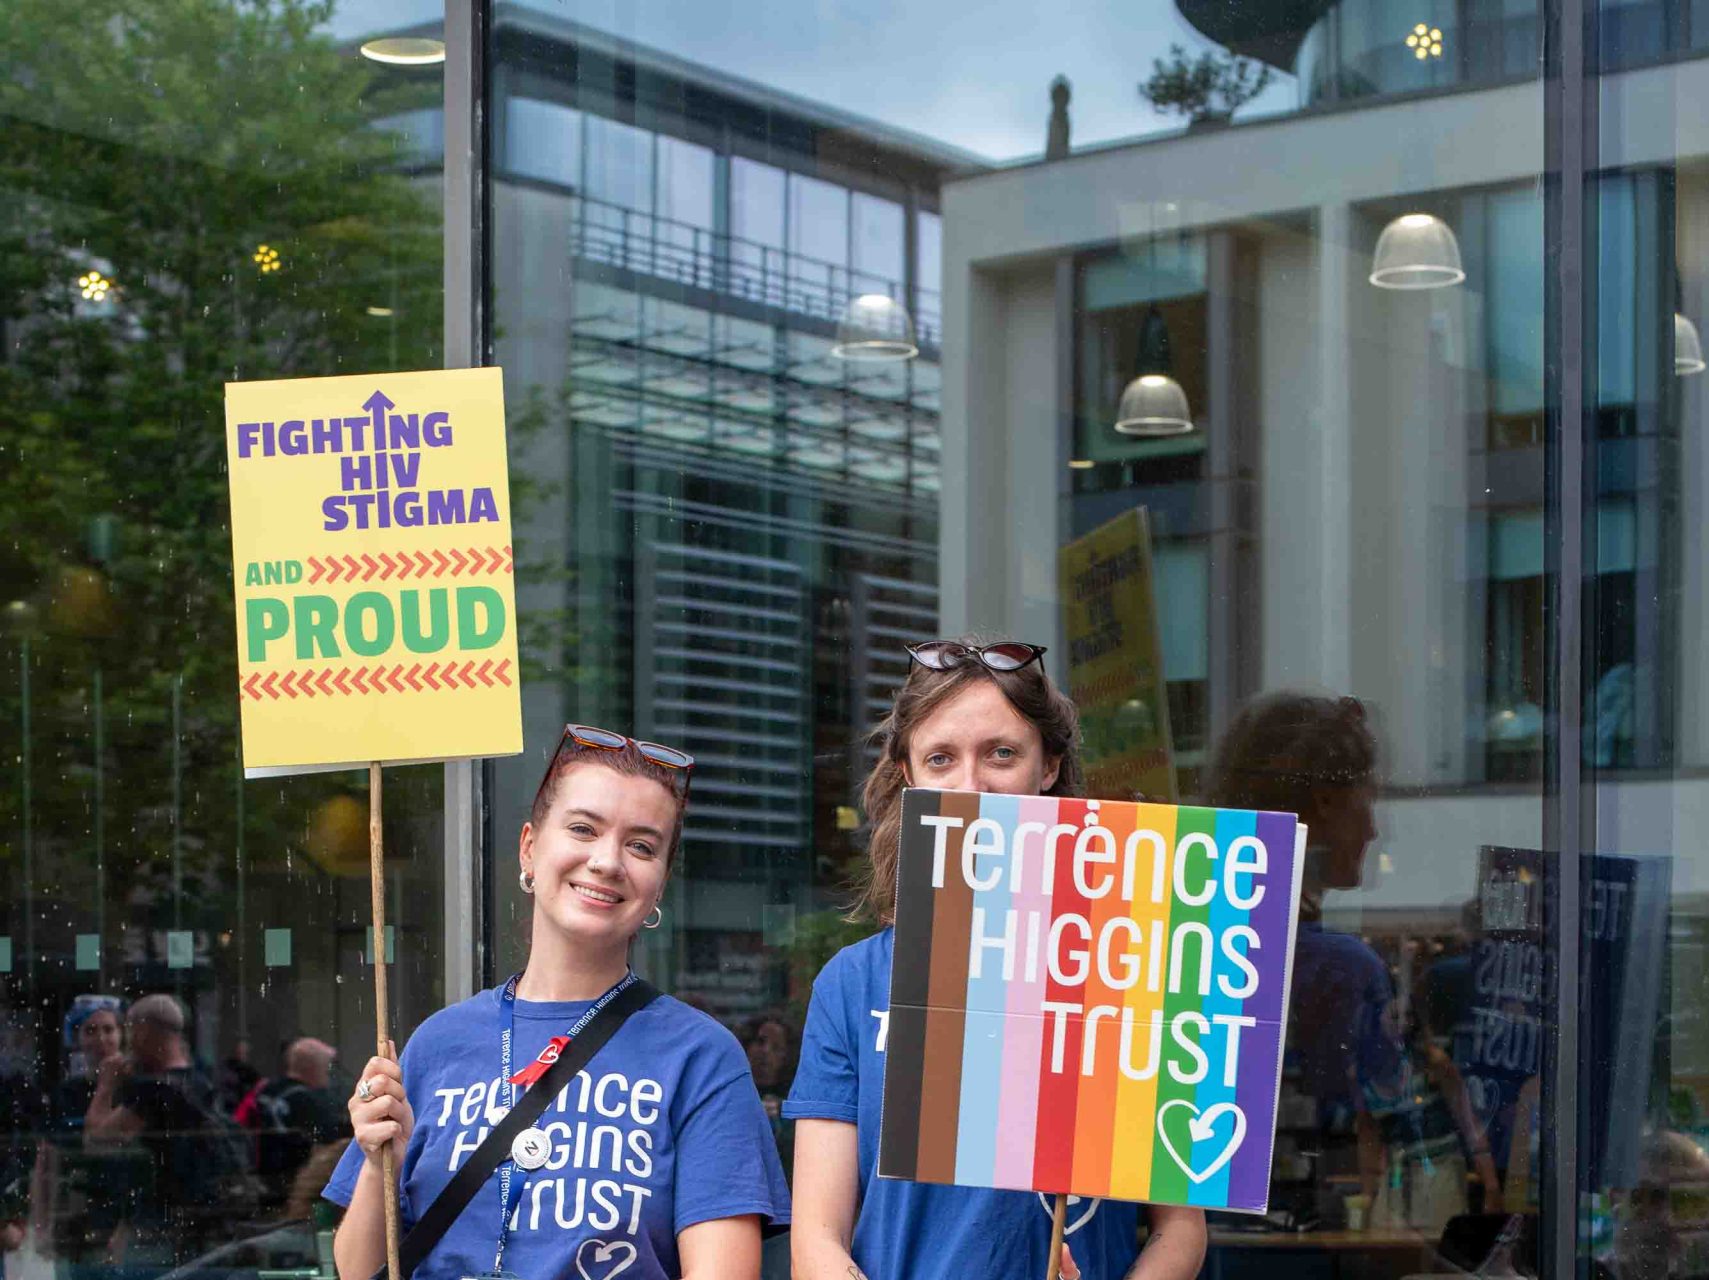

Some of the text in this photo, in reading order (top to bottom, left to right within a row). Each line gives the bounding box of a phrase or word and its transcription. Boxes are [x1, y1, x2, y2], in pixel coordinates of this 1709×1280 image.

[236, 410, 453, 458] FIGHTING
[340, 452, 420, 491] HIV
[322, 487, 499, 531] STIGMA
[245, 560, 303, 587] AND
[245, 586, 506, 663] PROUD
[920, 814, 1269, 911] Terrence
